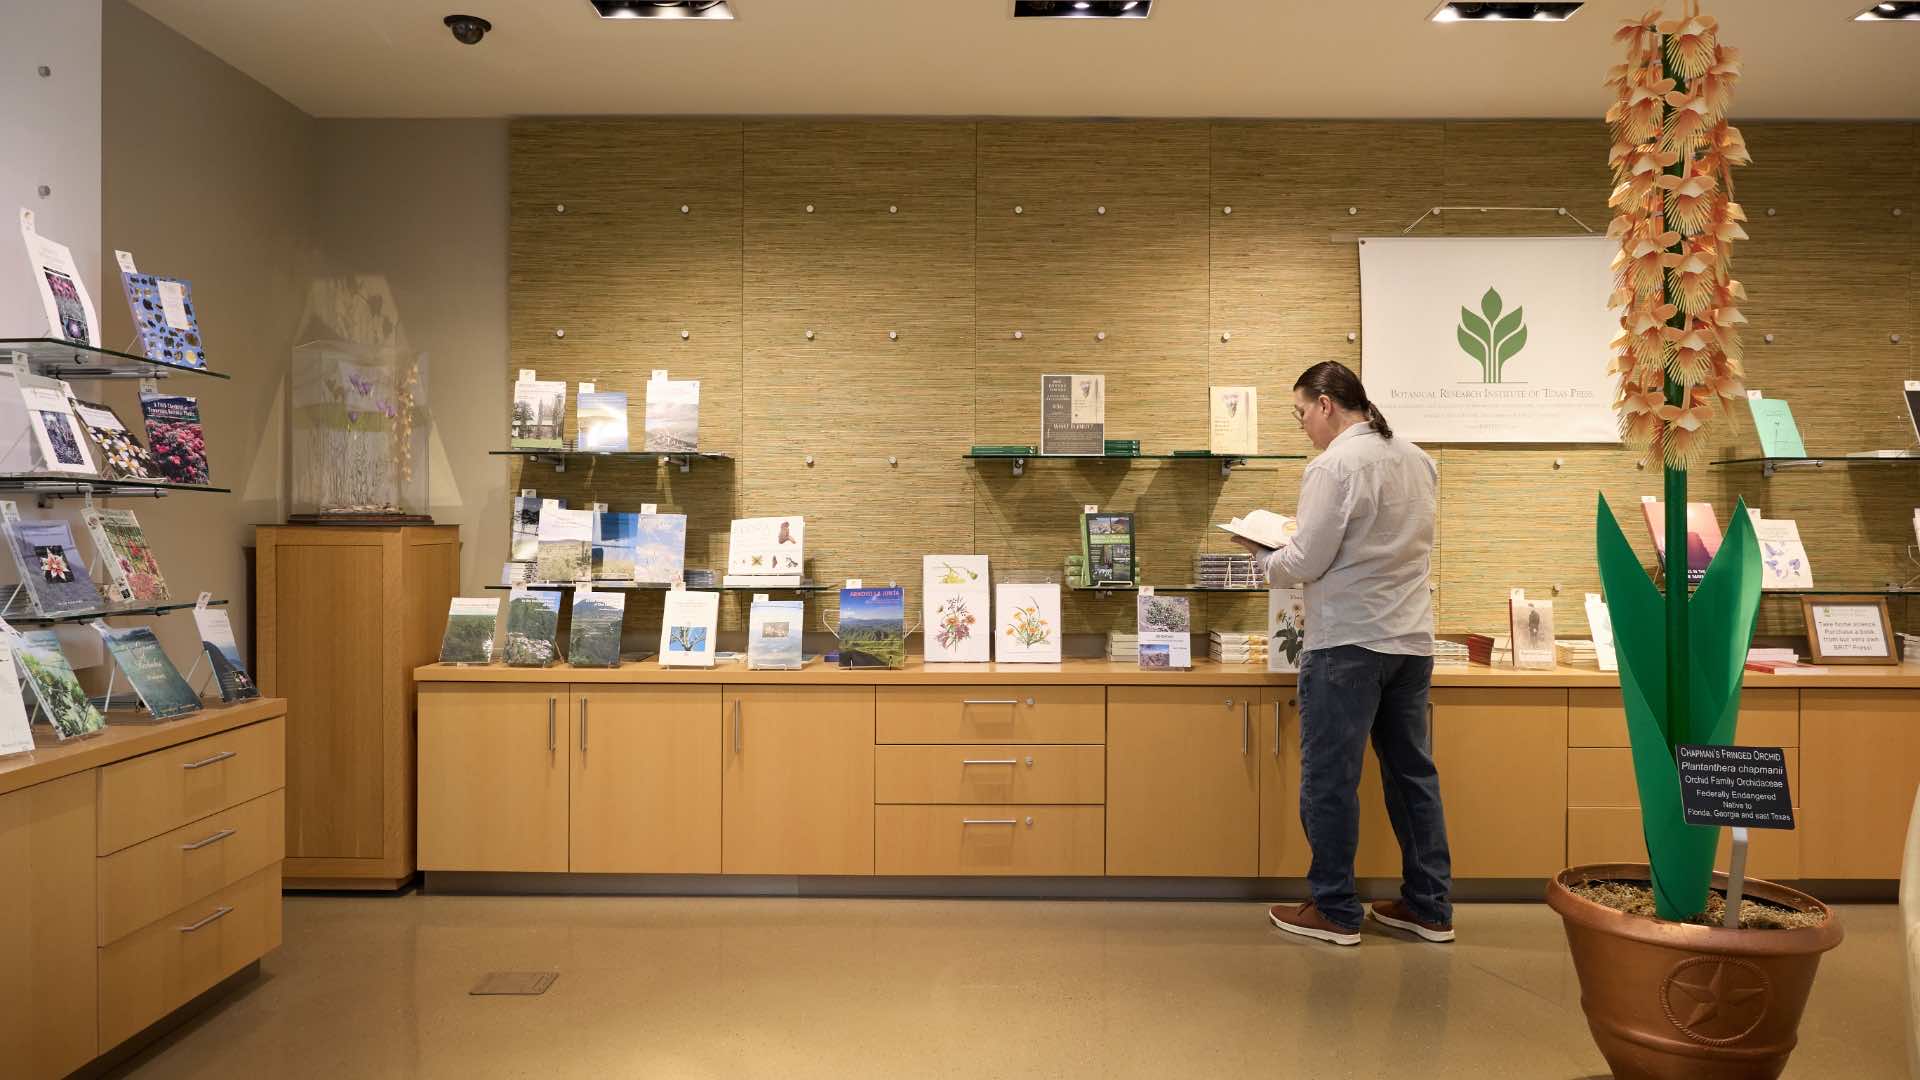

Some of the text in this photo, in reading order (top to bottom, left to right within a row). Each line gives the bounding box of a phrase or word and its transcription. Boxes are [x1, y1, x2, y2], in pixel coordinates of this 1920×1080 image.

[1391, 388, 1436, 399] BOTANICAL
[1484, 388, 1526, 398] INSTITUTE
[1680, 747, 1781, 761] CHAPMAN'S FRINGED ORCHID
[1681, 762, 1736, 773] Plantanthera
[1685, 775, 1783, 788] Orchid Family Orchidaceae
[1696, 789, 1777, 801] Federally Endangered
[1722, 801, 1744, 809] Native
[1741, 811, 1754, 819] and
